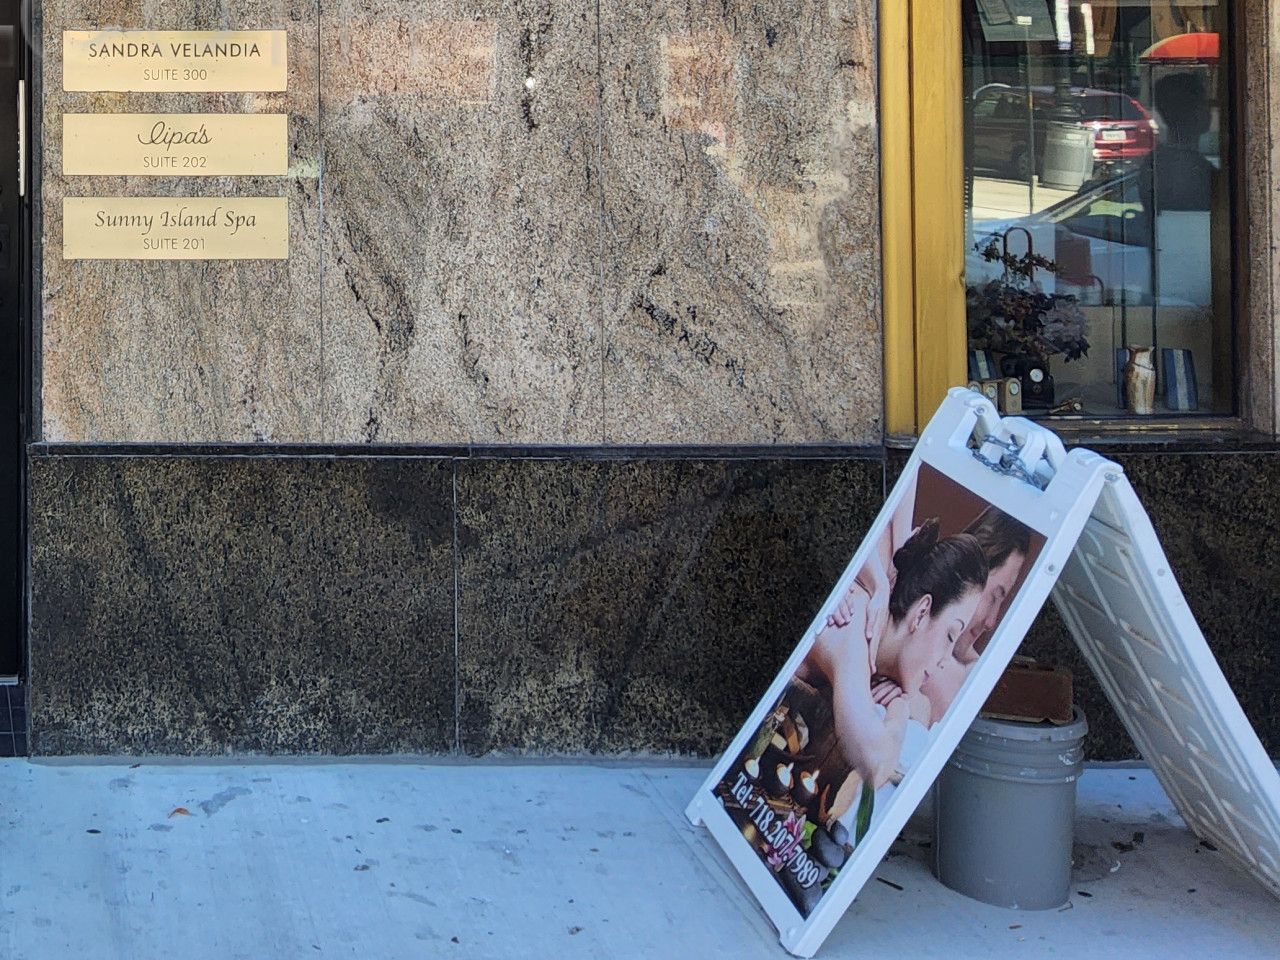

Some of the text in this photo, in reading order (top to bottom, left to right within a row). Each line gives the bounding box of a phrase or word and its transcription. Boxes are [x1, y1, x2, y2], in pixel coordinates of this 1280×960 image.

[88, 43, 261, 58] SANDRA VELANDIA
[143, 68, 207, 81] SUITE 300
[143, 156, 207, 168] SUITE 202
[94, 207, 257, 235] Sunny Island Spa
[143, 238, 206, 250] SUITE 201
[731, 771, 820, 889] Tel: 718.207.7989
